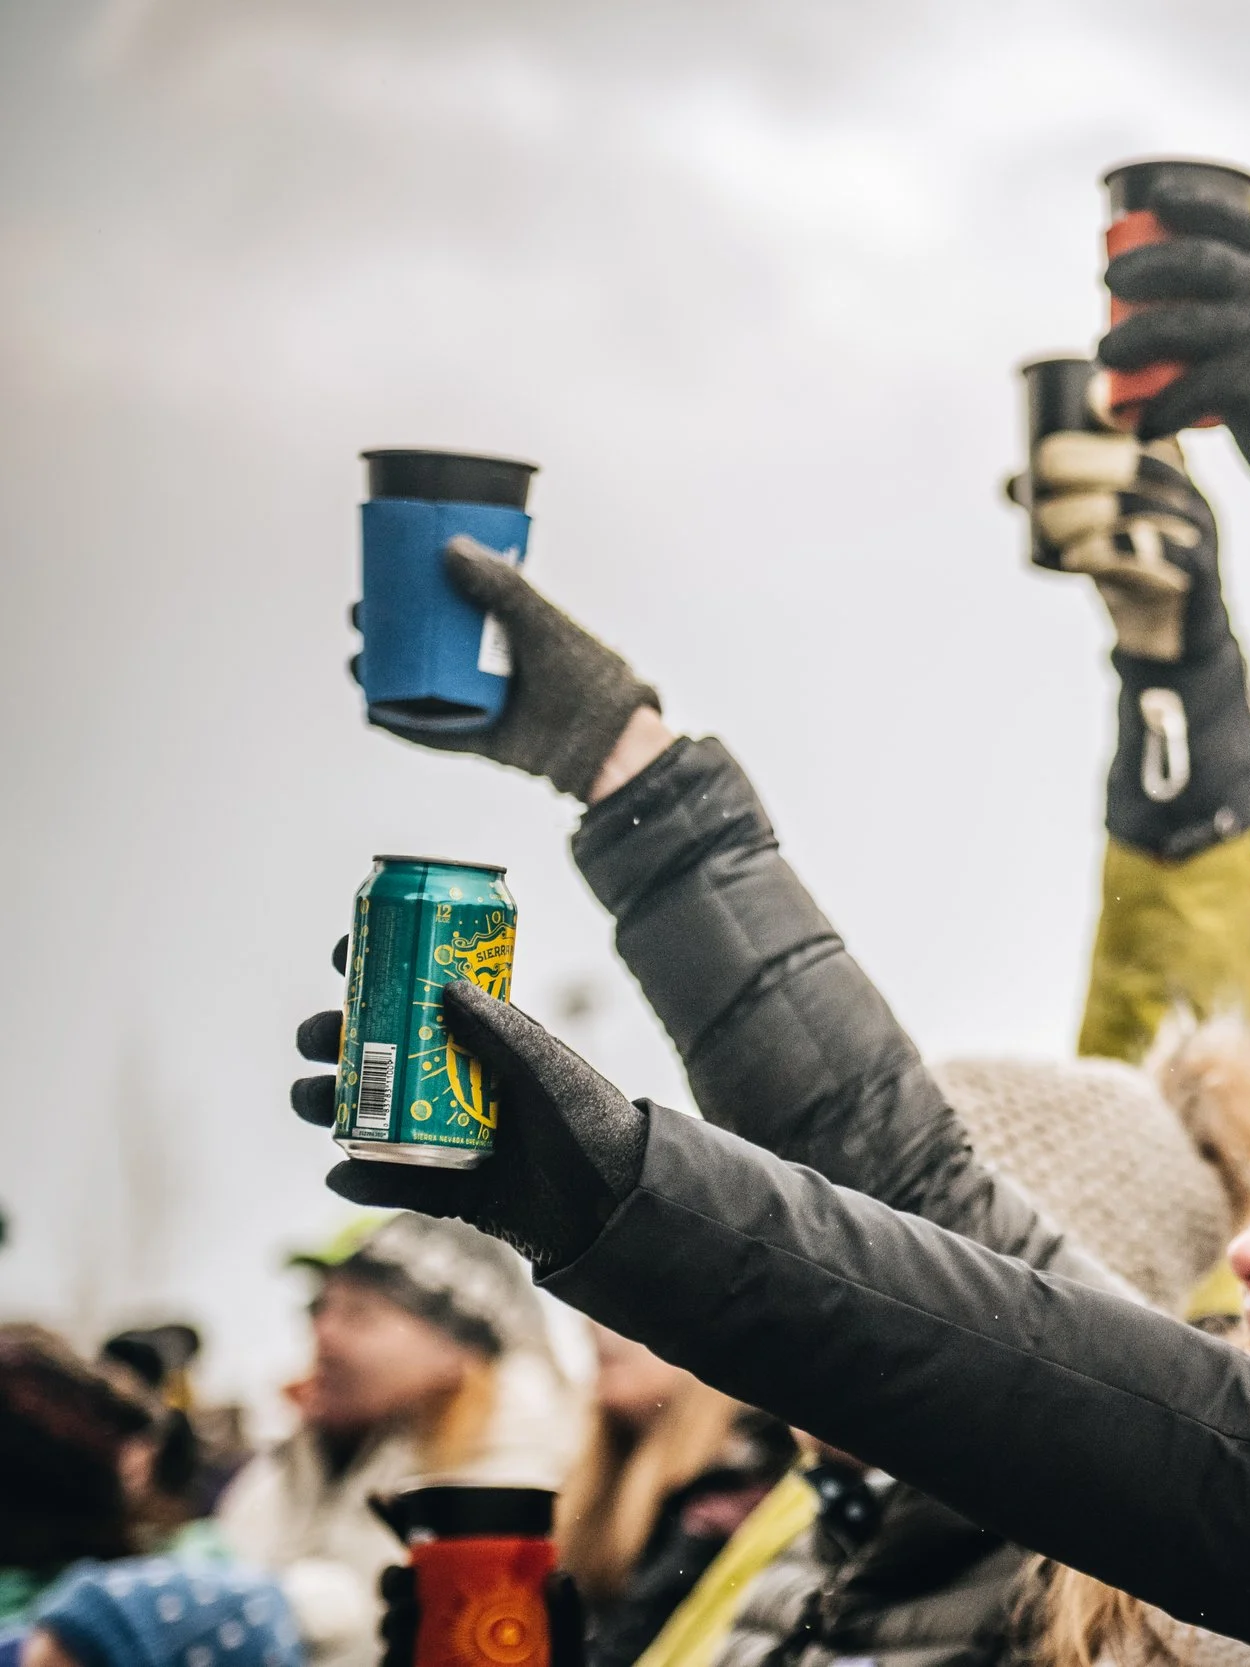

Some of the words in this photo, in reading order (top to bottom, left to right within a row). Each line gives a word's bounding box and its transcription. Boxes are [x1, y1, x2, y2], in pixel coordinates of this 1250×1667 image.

[436, 904, 451, 917] 12
[476, 945, 509, 963] SIERRA
[413, 1132, 437, 1141] SIERRA
[440, 1135, 464, 1144] NEVADA
